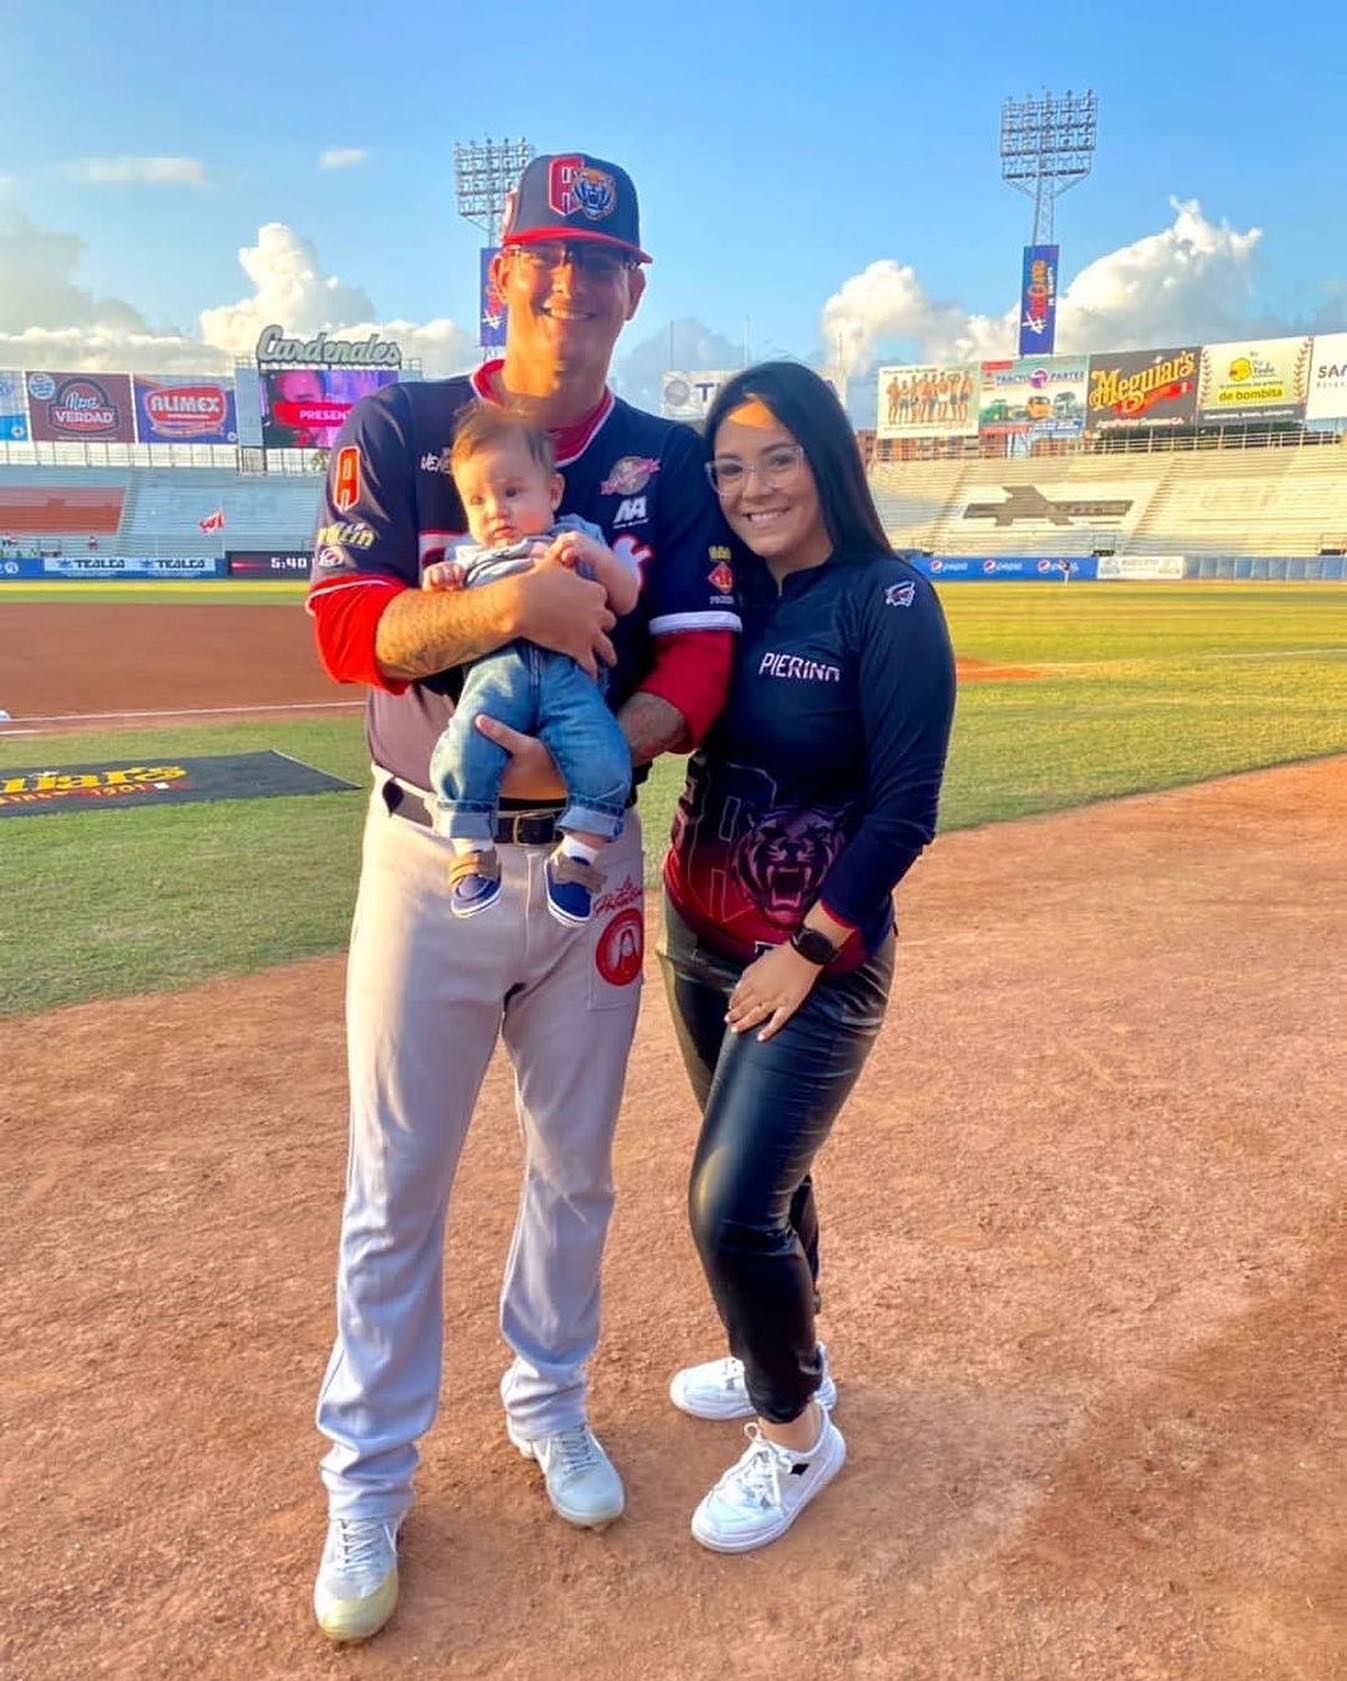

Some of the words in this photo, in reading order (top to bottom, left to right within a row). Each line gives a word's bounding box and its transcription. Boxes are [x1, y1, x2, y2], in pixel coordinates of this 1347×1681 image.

[256, 324, 402, 366] Cardenales
[1089, 350, 1196, 413] Meguiar's
[151, 395, 221, 413] ALIMEX
[55, 409, 116, 424] VERDAD
[299, 409, 350, 421] PRESEN
